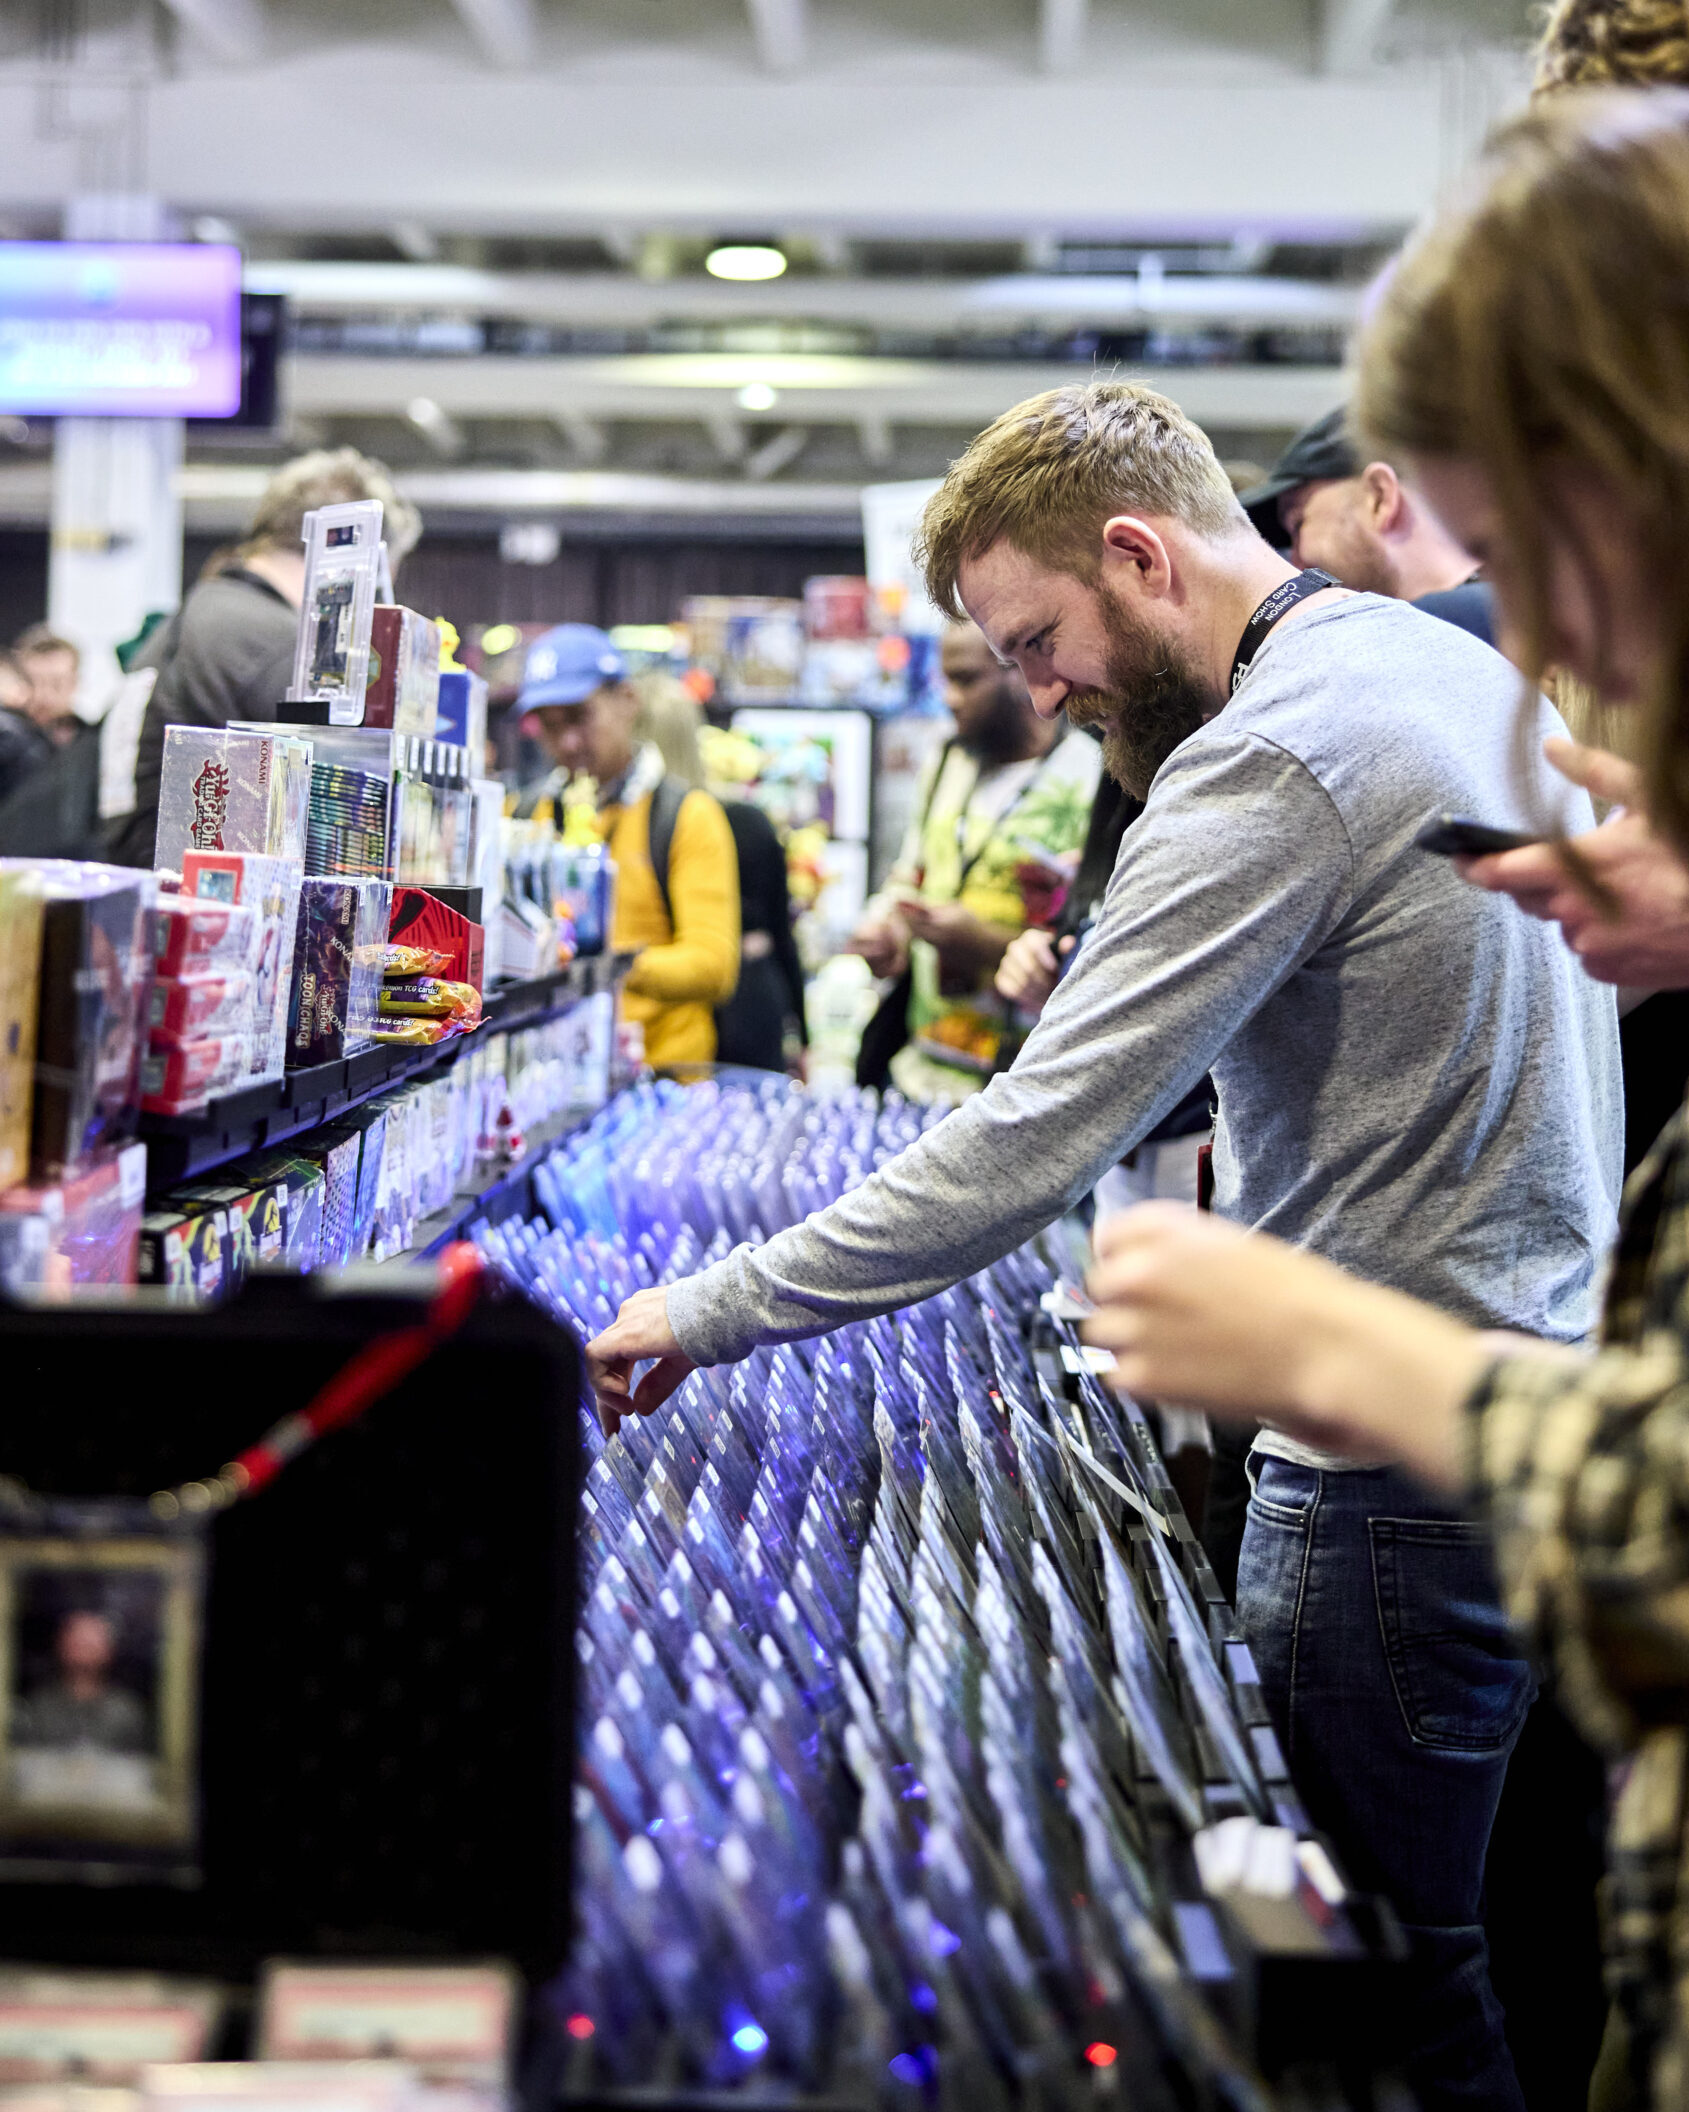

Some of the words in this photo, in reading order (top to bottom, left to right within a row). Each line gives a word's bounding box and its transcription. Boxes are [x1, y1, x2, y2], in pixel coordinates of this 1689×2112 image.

[1272, 582, 1297, 600] CARD
[1250, 600, 1275, 626] SHOW
[1264, 592, 1301, 621] LONDON
[258, 740, 269, 785] KONAMI
[341, 889, 351, 925] KONAMI
[331, 936, 352, 962] KONA
[302, 974, 314, 1006] TOON
